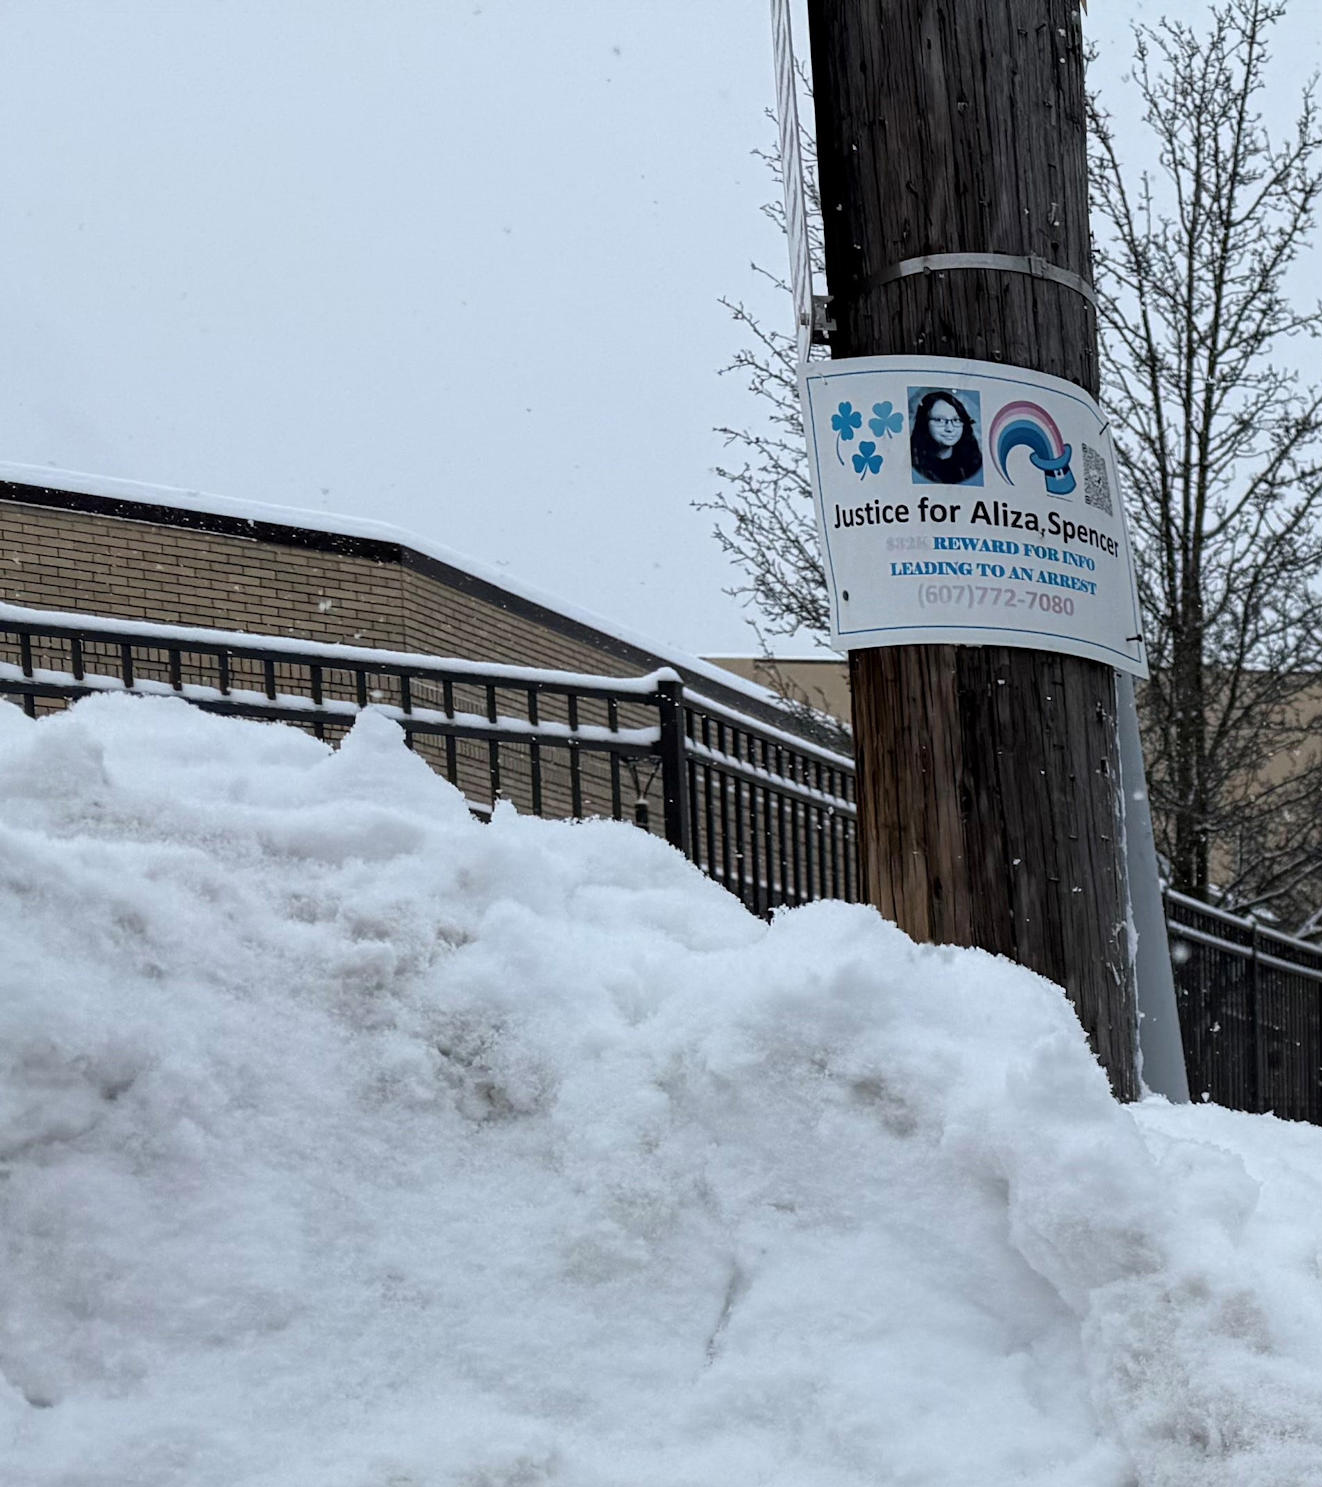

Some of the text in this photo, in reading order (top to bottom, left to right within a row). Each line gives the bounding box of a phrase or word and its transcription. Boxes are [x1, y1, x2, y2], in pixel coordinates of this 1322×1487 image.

[834, 499, 910, 529] Justice
[917, 496, 961, 523] for
[1048, 511, 1119, 558] Spencer
[933, 536, 1020, 556] REWARD
[1022, 543, 1060, 562] FOR
[1062, 550, 1096, 572] INFO
[890, 561, 1098, 596] LEADING TO AN ARREST
[918, 583, 1075, 617] (607)772-7080
